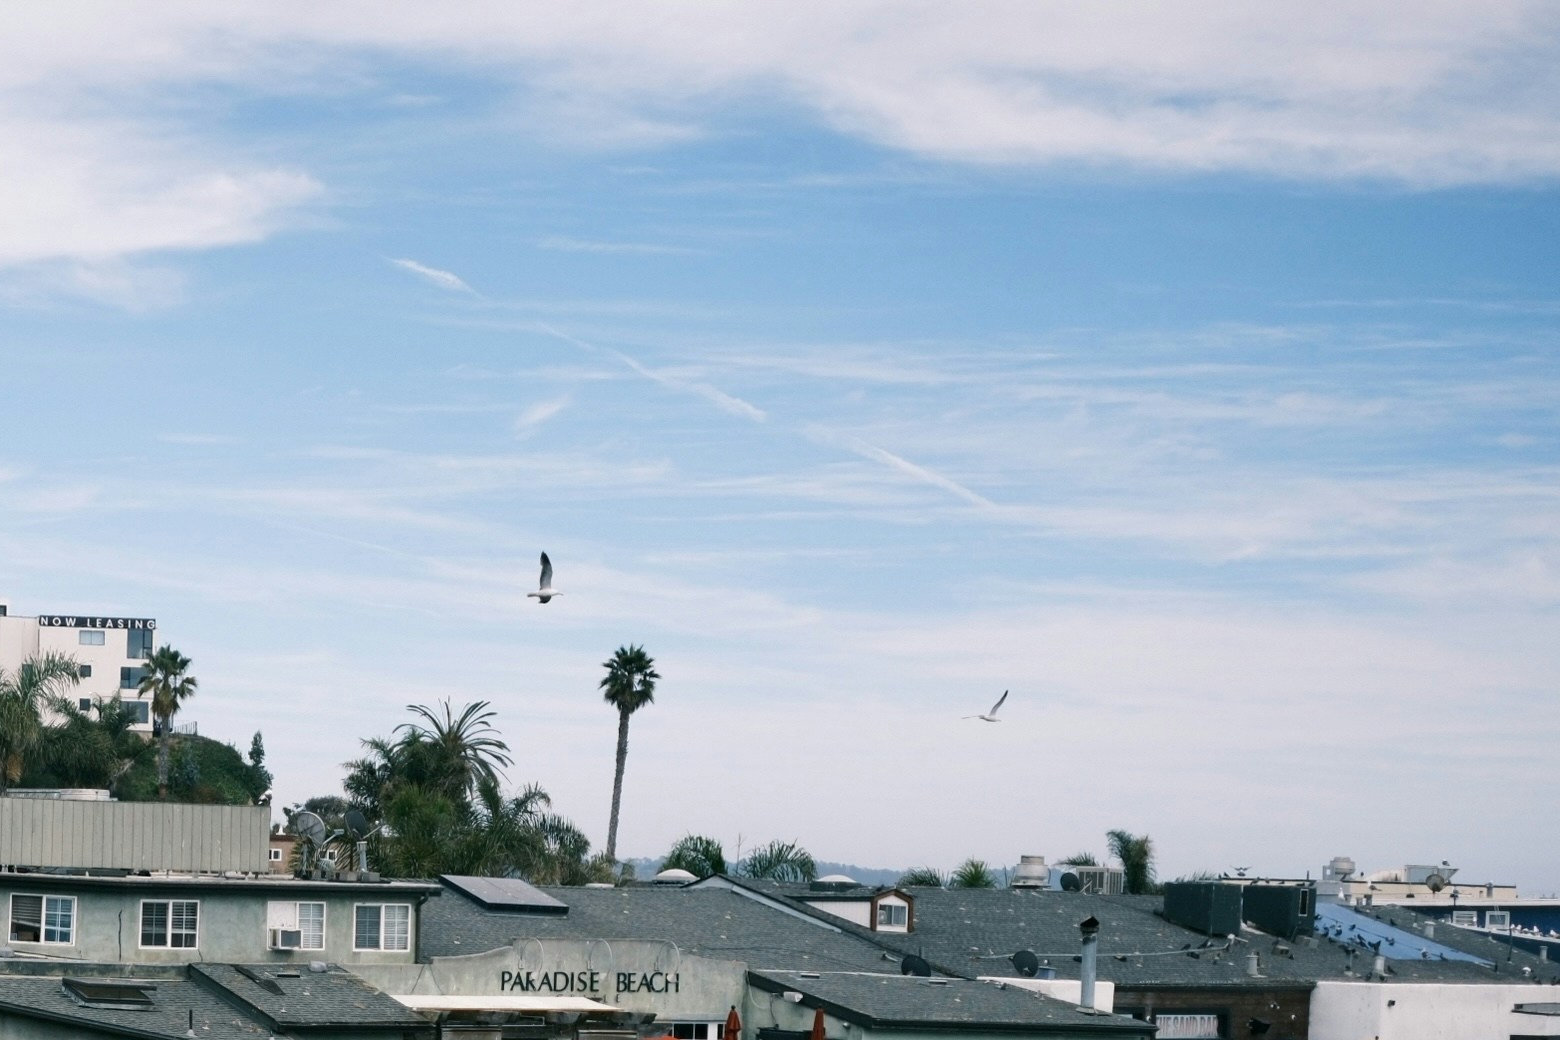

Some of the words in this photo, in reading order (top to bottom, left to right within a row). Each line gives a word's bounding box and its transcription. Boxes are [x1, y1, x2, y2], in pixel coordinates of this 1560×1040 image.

[40, 616, 76, 627] NOW
[87, 618, 156, 629] LEASING
[500, 970, 600, 992] PARADISE
[616, 972, 680, 993] BEACH
[1156, 1015, 1172, 1035] THE
[1173, 1015, 1198, 1036] SAND
[1200, 1015, 1218, 1036] BAR
